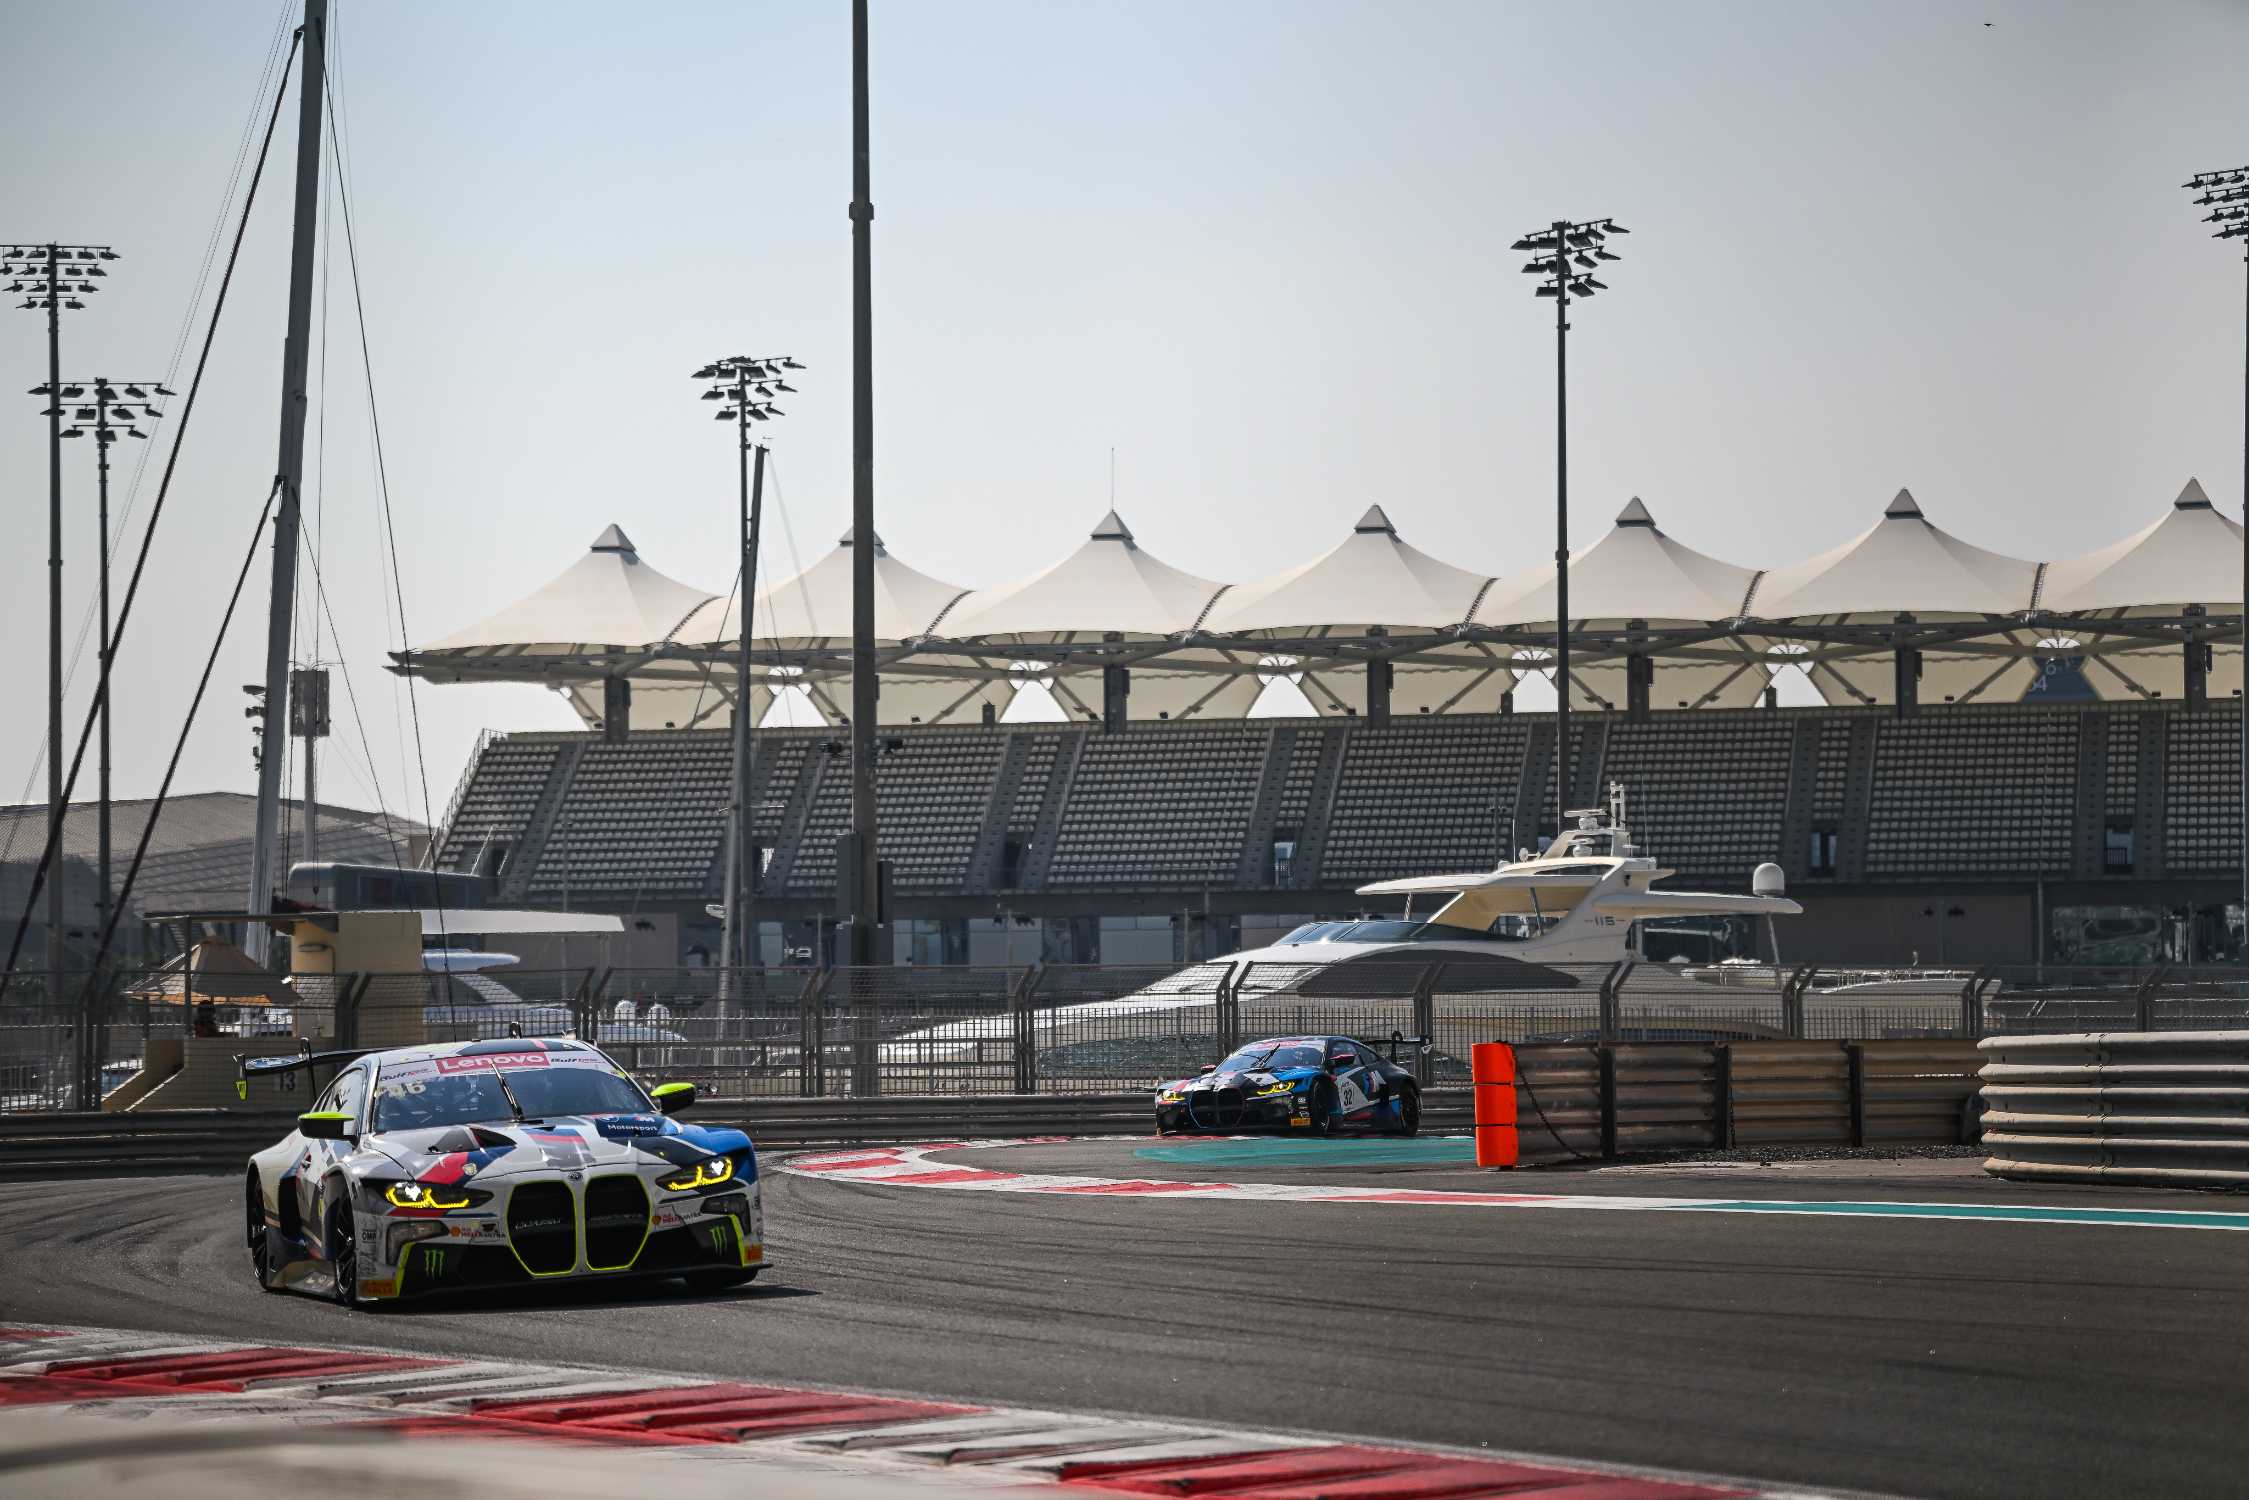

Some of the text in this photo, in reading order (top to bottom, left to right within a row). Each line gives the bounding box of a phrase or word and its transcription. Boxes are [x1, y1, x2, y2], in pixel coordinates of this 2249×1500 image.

[441, 1054, 544, 1071] Lenovo
[279, 1071, 296, 1091] 13
[1343, 1089, 1353, 1107] 32
[607, 1123, 658, 1132] Motorsport
